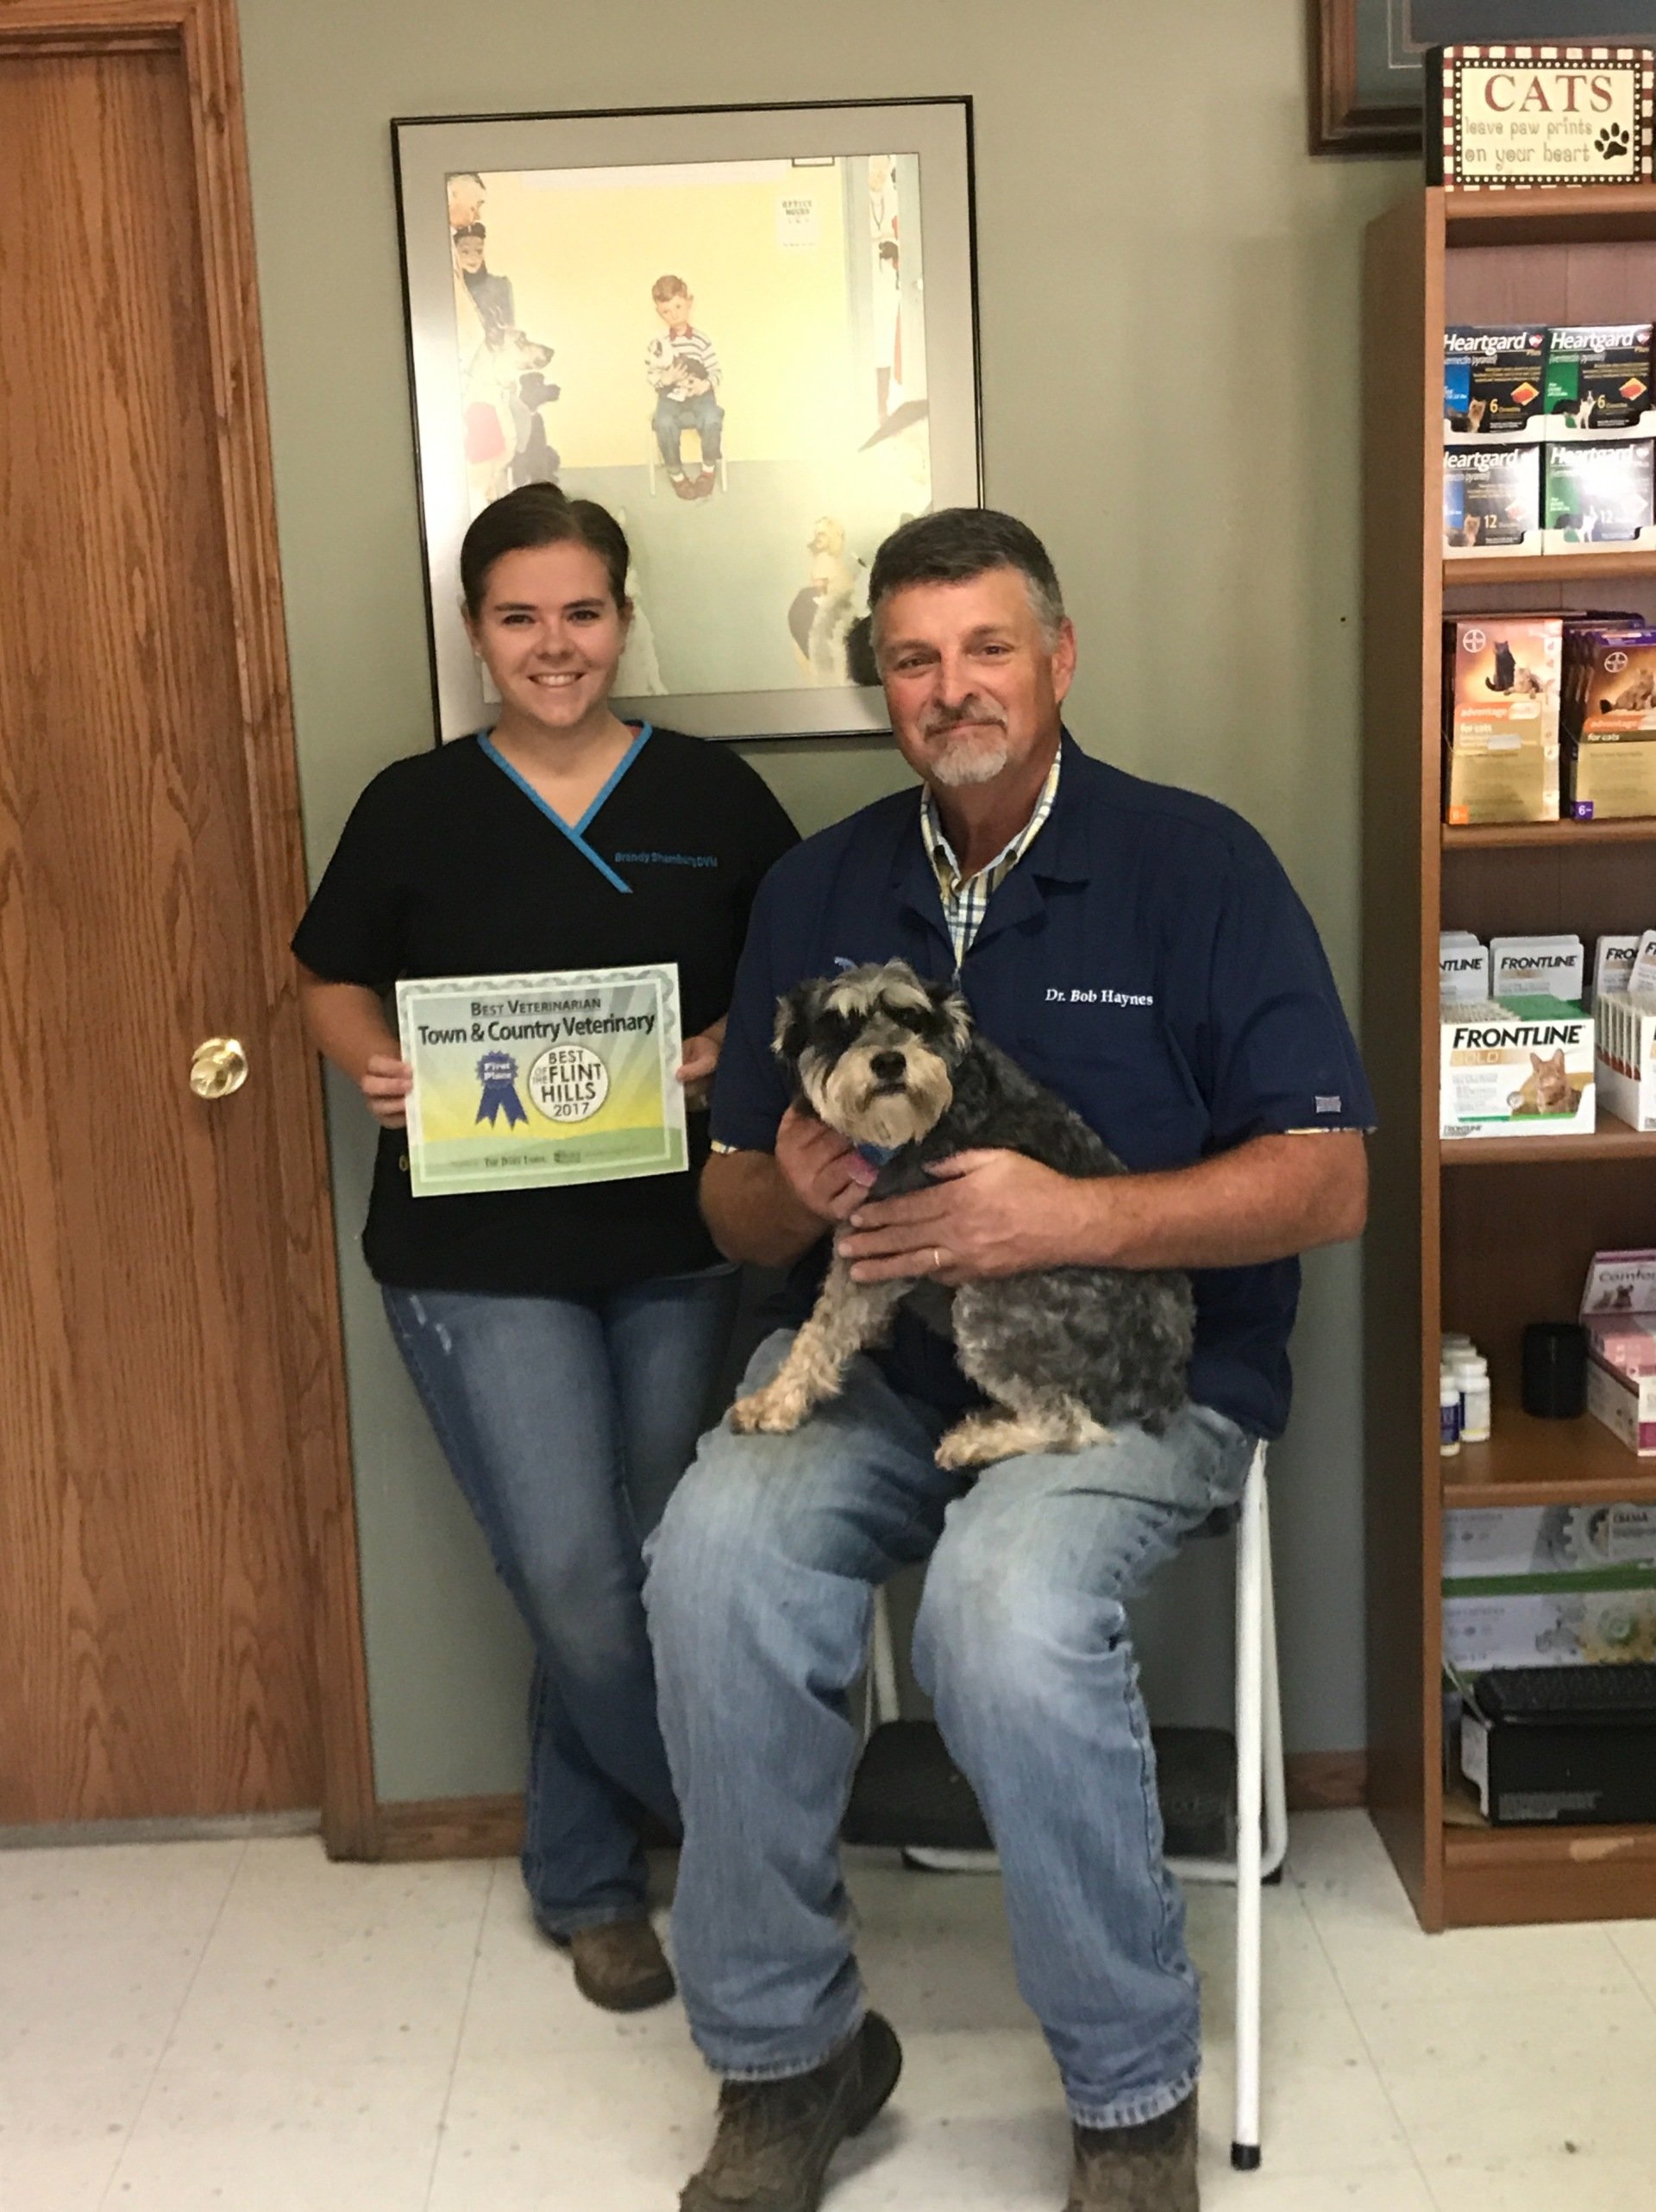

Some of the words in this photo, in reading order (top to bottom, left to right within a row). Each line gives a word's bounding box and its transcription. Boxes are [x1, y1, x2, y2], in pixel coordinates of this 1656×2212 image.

[1484, 74, 1613, 112] CATS
[1465, 116, 1503, 135] leave
[1510, 123, 1539, 140] paw
[1546, 116, 1592, 140] prints
[1465, 147, 1487, 162] on
[1495, 148, 1535, 172] your
[1543, 142, 1590, 162] heart
[1444, 332, 1527, 356] Heartgard
[1550, 330, 1634, 353] Heartgard
[1490, 399, 1499, 413] 6
[1597, 394, 1606, 409] 6
[1484, 514, 1497, 528] 12
[1578, 805, 1586, 815] 6
[1500, 955, 1578, 970] FRONTLINE
[471, 1002, 504, 1016] BEST
[507, 998, 601, 1014] VETERINARIAN
[1044, 989, 1066, 1001] Dr.
[1070, 990, 1097, 1002] Bob
[1101, 990, 1154, 1008] Haynes
[417, 1025, 467, 1045] Town
[471, 1022, 485, 1042] &
[488, 1021, 561, 1043] Country
[562, 1013, 655, 1036] Veterinary
[1452, 1025, 1583, 1048] FRONTLINE
[548, 1050, 584, 1065] BEST
[1454, 1052, 1499, 1064] OLD
[534, 1066, 547, 1076] OF
[549, 1063, 602, 1084] FLINT
[541, 1082, 597, 1103] HILLS
[553, 1102, 590, 1117] 2017
